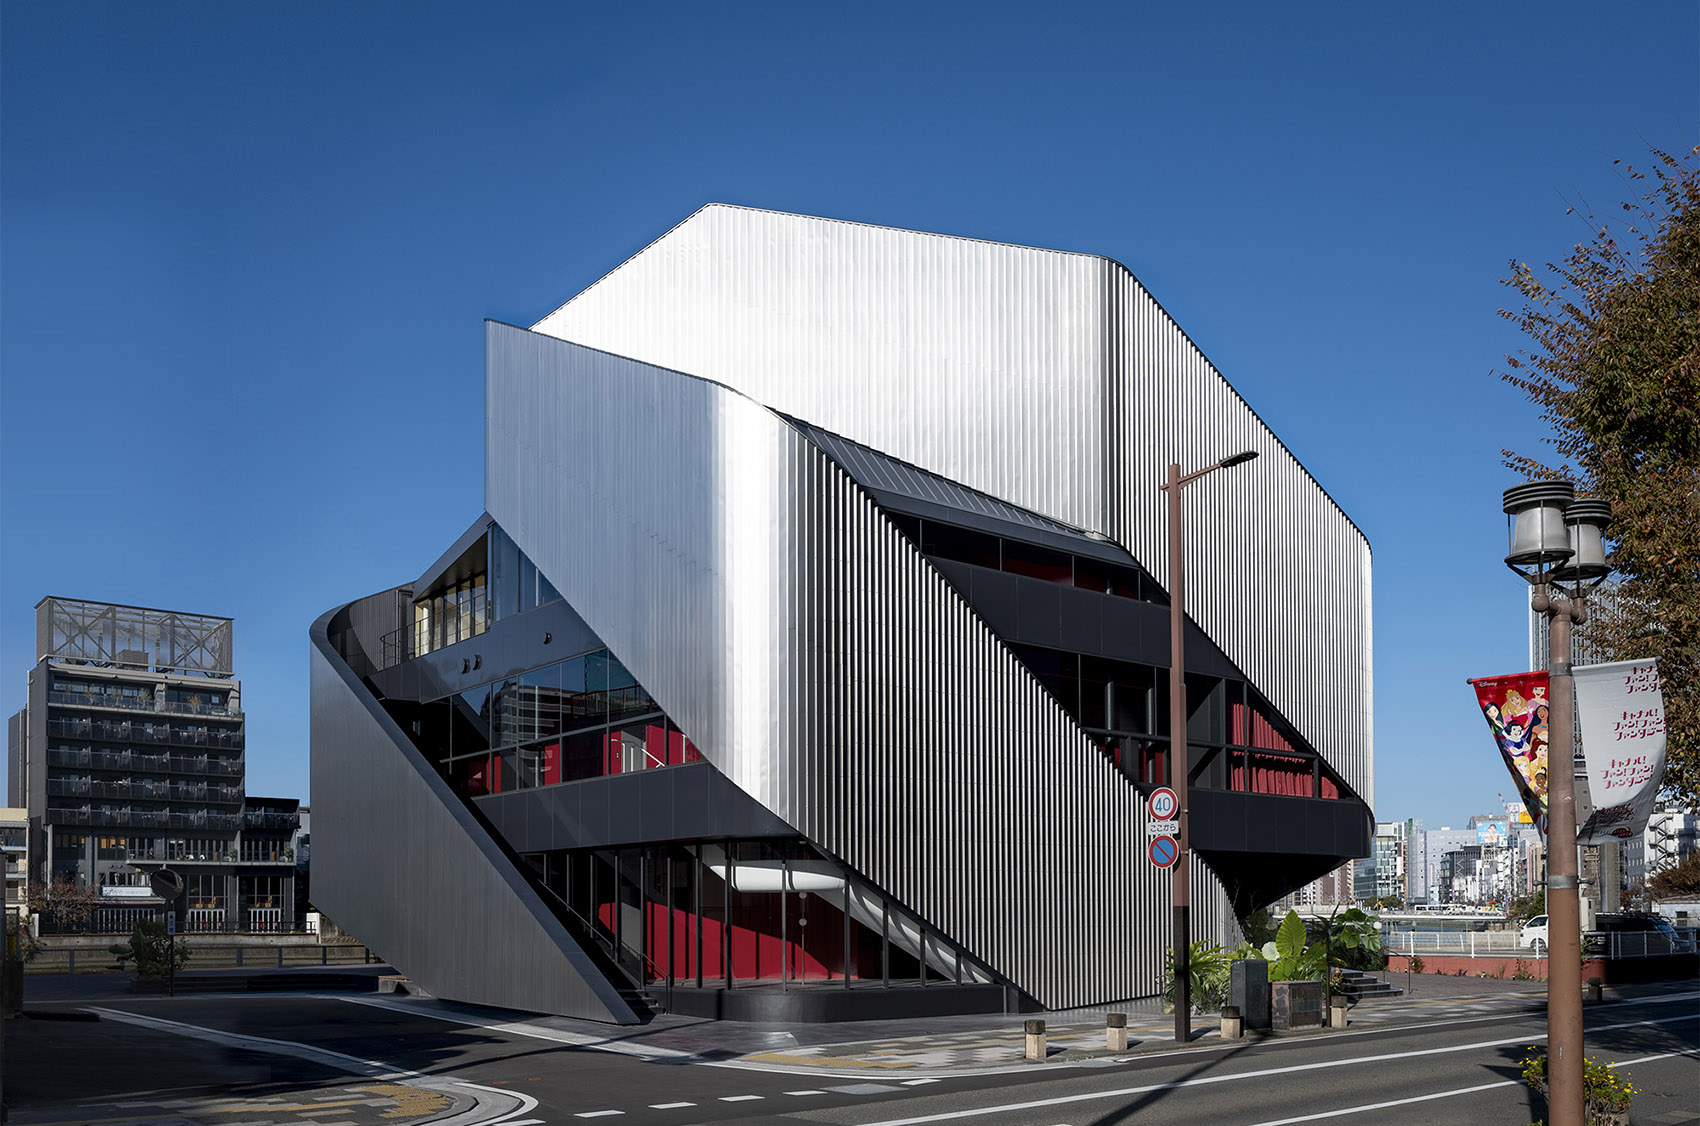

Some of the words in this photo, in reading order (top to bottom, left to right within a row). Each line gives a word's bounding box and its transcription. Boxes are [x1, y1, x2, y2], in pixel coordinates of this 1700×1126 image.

[1155, 797, 1171, 812] 40
[1150, 823, 1177, 833] ここから
